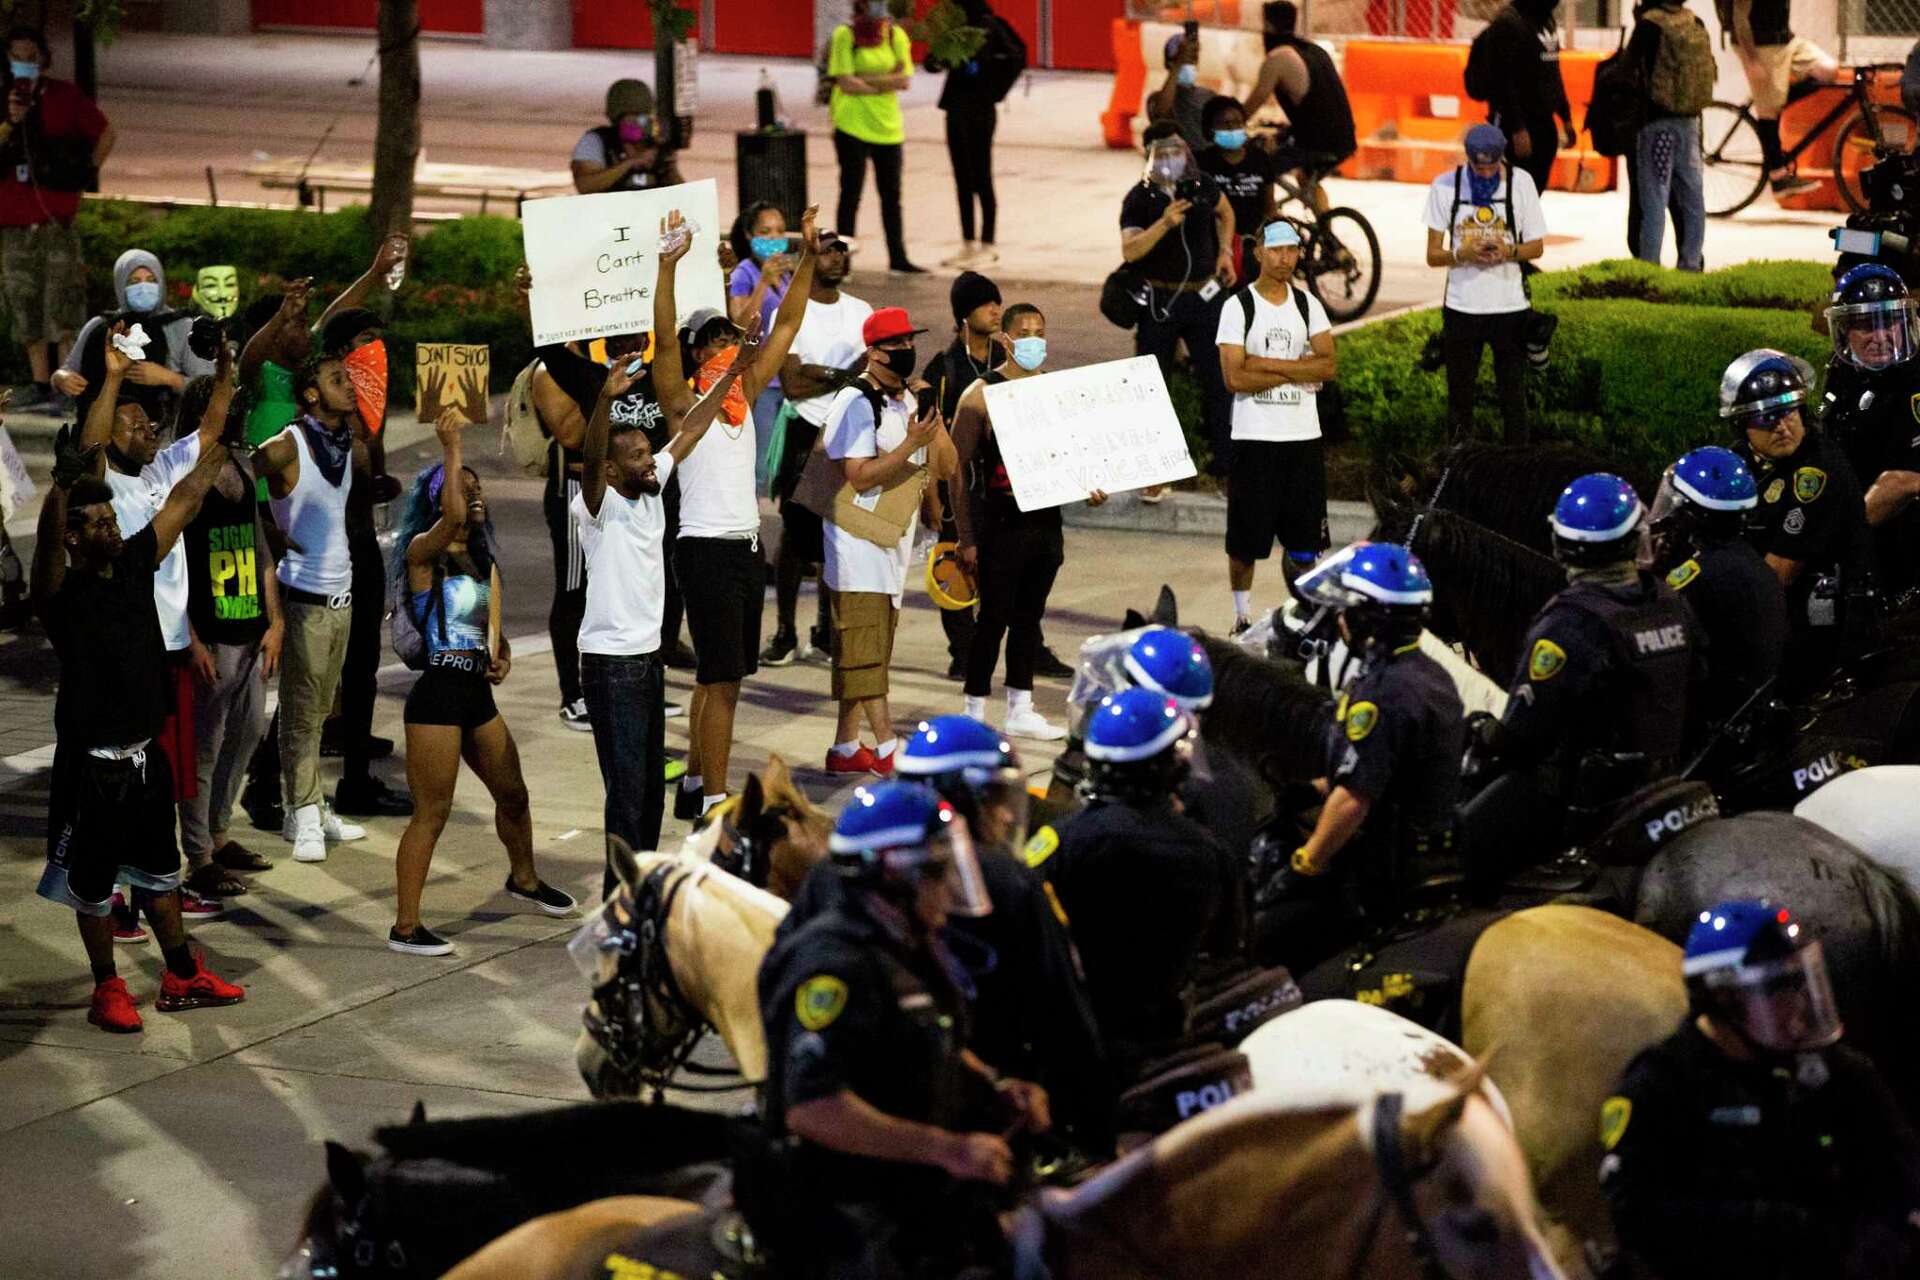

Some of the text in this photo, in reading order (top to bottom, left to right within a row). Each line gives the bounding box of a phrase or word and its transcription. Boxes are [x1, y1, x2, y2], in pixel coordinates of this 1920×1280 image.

[613, 226, 630, 242] I
[584, 286, 650, 310] Breathe
[1066, 453, 1158, 491] VOICE
[1635, 624, 1686, 653] POLICE
[441, 654, 474, 671] PRO
